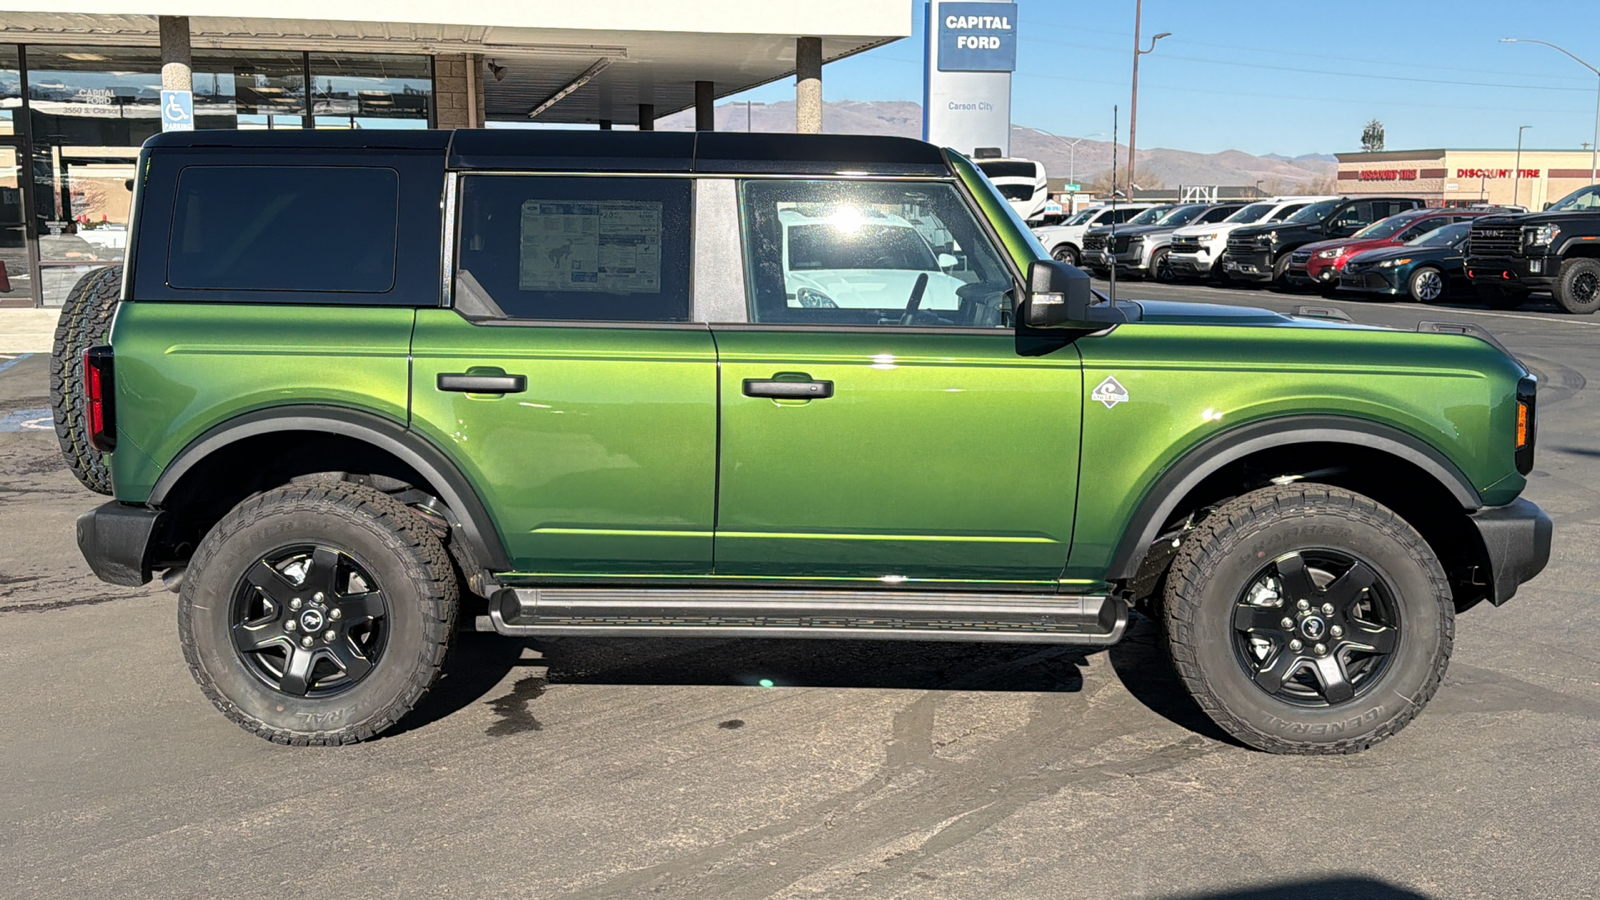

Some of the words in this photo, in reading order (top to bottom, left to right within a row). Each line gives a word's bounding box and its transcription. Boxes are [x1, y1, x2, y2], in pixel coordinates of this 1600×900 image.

[945, 15, 1012, 30] CAPITAL
[957, 36, 1001, 49] FORD
[78, 88, 115, 97] CAPITAL
[86, 97, 112, 105] FORD
[948, 101, 977, 111] Carson
[978, 102, 994, 112] City
[164, 122, 192, 130] PARKING
[1359, 169, 1399, 182] DISCOUNT
[1457, 168, 1514, 179] DISCOUNT
[1515, 168, 1541, 179] TIRE
[1261, 705, 1386, 736] GENERAL
